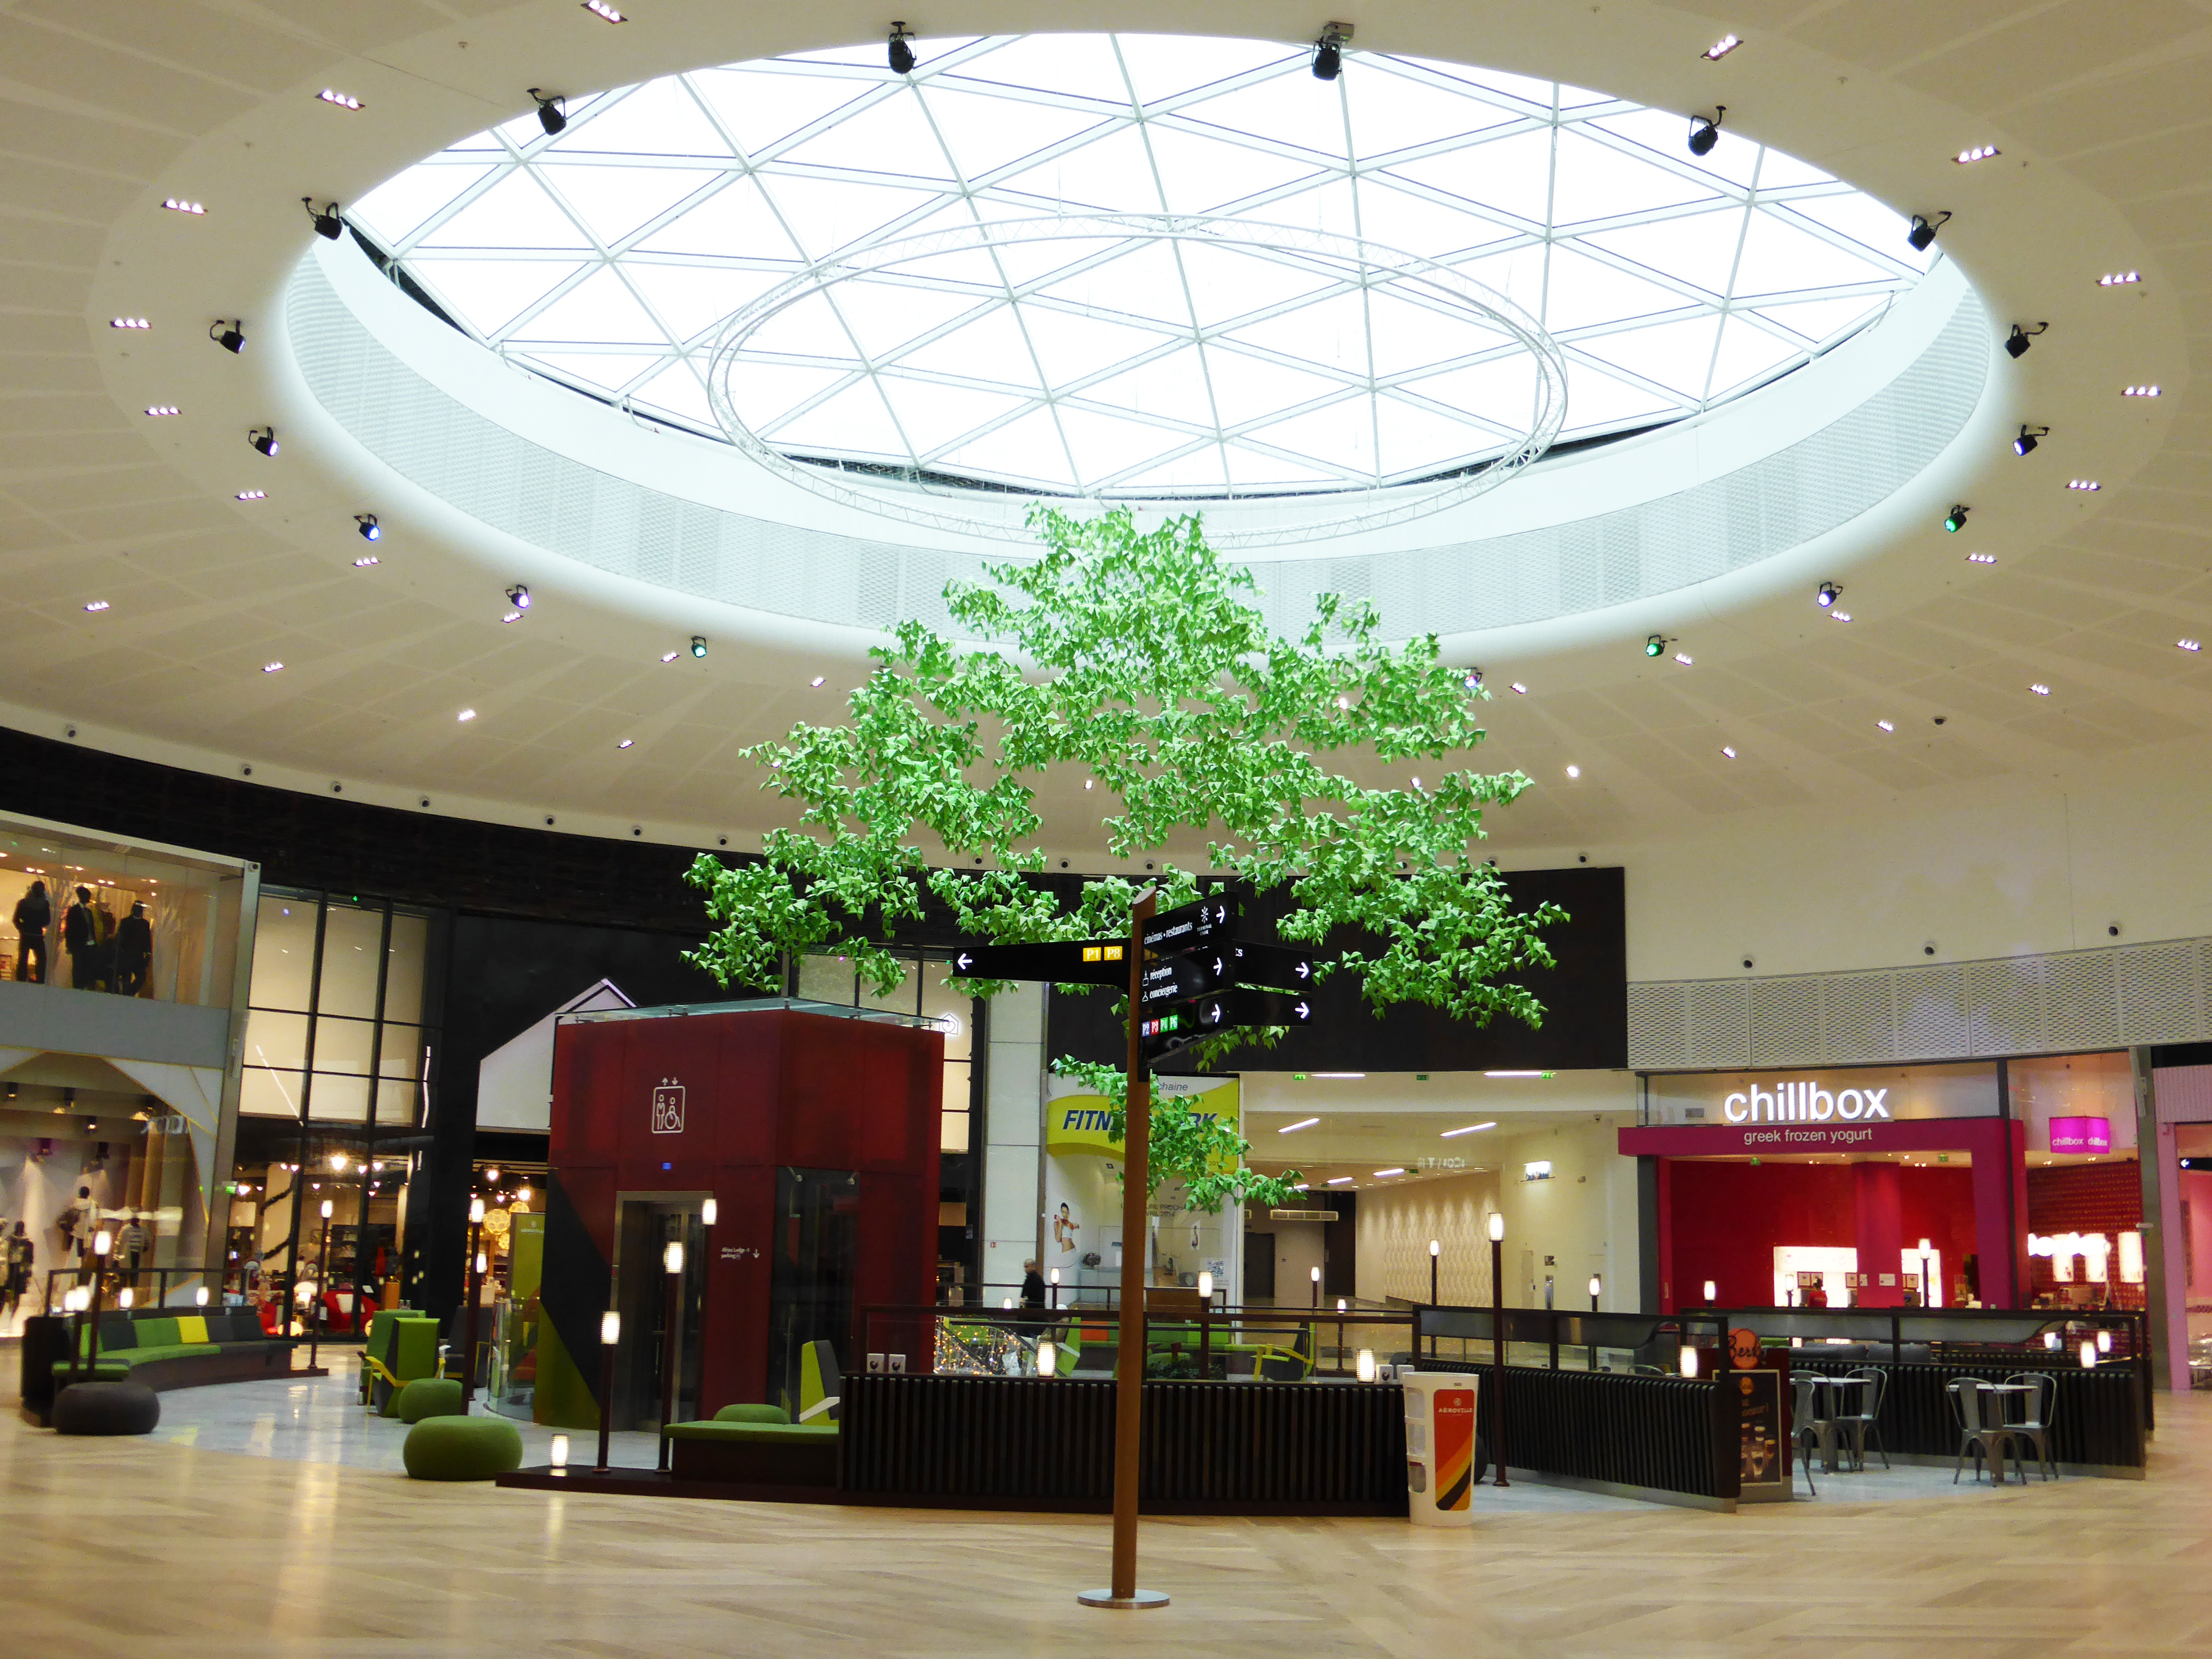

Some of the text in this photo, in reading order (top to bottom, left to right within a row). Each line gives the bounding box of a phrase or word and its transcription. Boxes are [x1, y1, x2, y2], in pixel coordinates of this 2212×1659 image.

[1166, 921, 1193, 938] restaurants
[1087, 948, 1120, 960] P1 P8
[1150, 965, 1172, 980] réception
[1149, 982, 1178, 998] conciergerie
[1142, 1016, 1177, 1036] P2 P3 P4 P6
[1158, 1082, 1188, 1091] chaine
[1724, 1081, 1890, 1122] chillbox
[1744, 1129, 1872, 1145] greek frozen yogurt
[2052, 1137, 2084, 1146] chillbox
